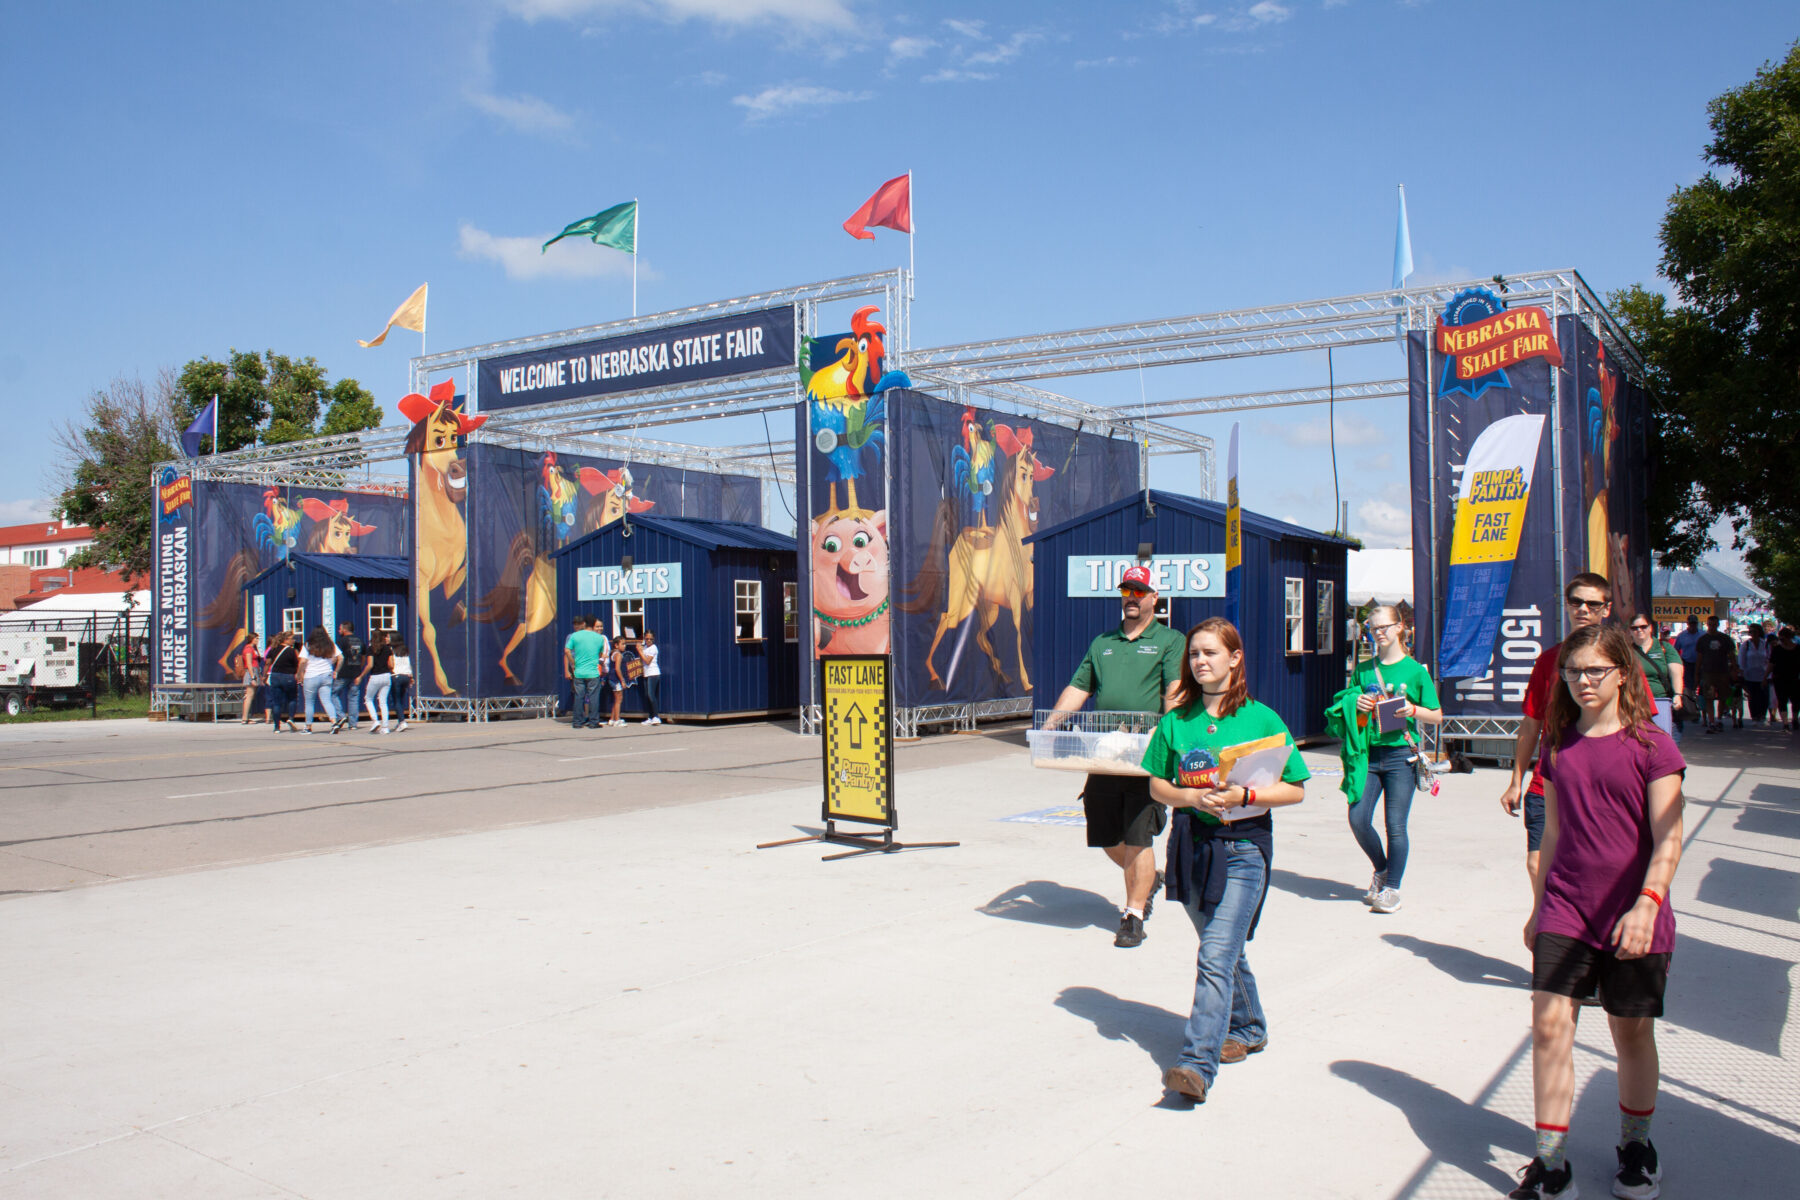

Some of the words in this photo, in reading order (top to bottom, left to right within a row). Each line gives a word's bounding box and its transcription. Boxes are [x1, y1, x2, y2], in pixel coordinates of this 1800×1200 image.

[1443, 312, 1541, 352] NEBRASKA
[500, 360, 566, 394] WELCOME
[570, 357, 587, 384] TO
[591, 343, 670, 380] NEBRASKA
[673, 334, 721, 368] STATE
[726, 327, 765, 359] FAIR
[1462, 344, 1508, 378] STATE
[1513, 334, 1549, 359] FAIR
[1469, 481, 1528, 505] PANTRY
[1471, 527, 1509, 543] LANE
[1474, 512, 1511, 528] FAST
[161, 533, 174, 609] NOTHING
[174, 526, 188, 630] NEBRASKAN
[588, 567, 669, 597] TICKETS
[1086, 558, 1210, 592] TICETS
[1654, 606, 1711, 615] RMATION
[161, 614, 174, 684] THERE'S
[174, 634, 188, 684] MORE
[829, 665, 853, 685] FAST
[856, 665, 883, 685] LANE
[842, 758, 870, 774] Pump
[845, 773, 875, 792] Pantry
